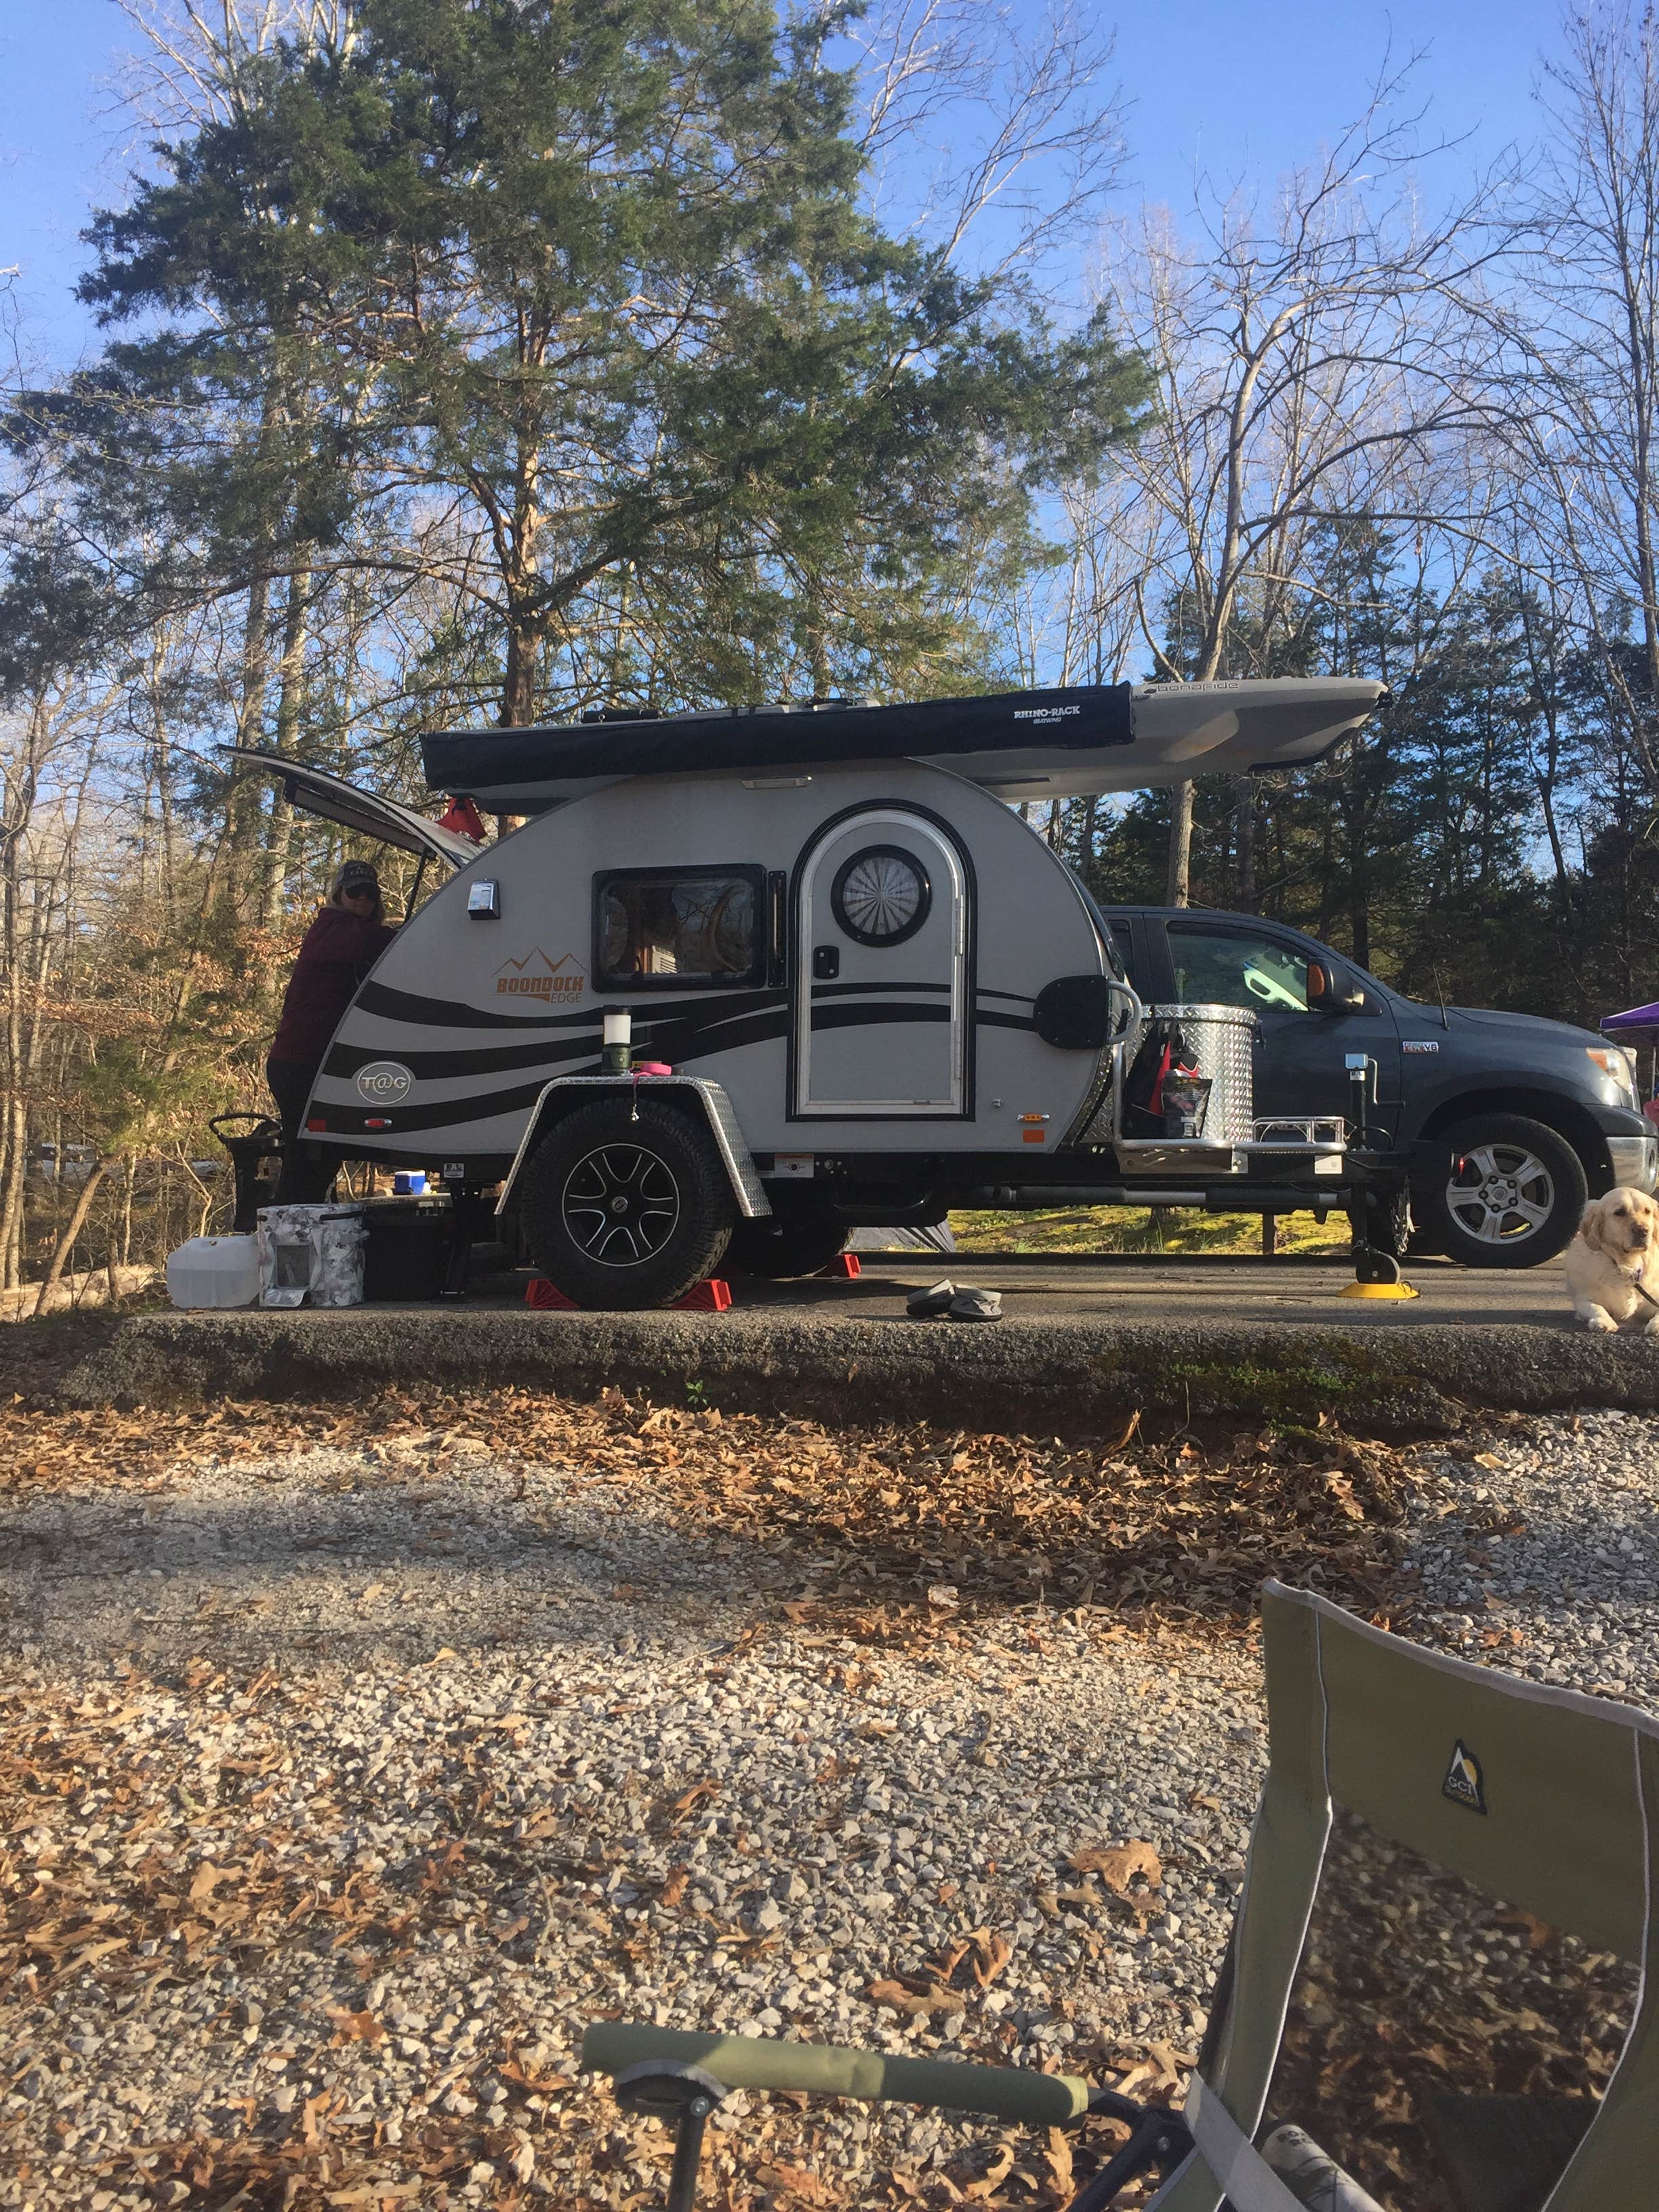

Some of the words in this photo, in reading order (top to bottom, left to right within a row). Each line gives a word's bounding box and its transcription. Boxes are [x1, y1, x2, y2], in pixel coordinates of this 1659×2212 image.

[1158, 681, 1239, 692] bonafide
[1014, 705, 1080, 719] RHINO-RACK
[497, 976, 584, 993] BOONDOCK
[551, 992, 581, 1003] EDGE
[361, 1073, 407, 1094] T@G
